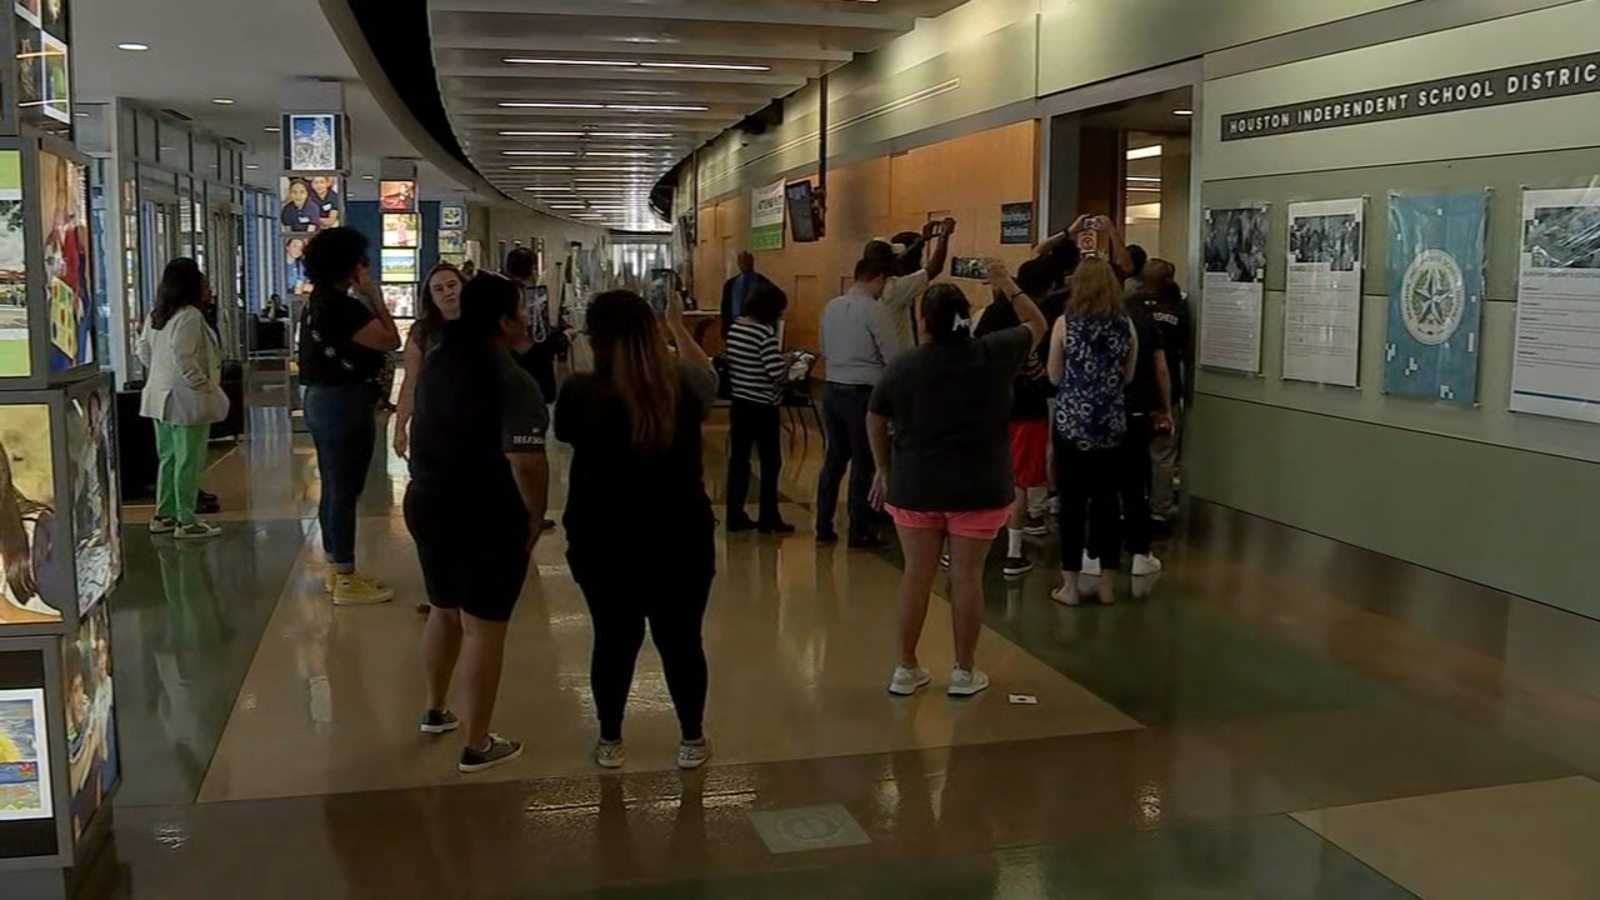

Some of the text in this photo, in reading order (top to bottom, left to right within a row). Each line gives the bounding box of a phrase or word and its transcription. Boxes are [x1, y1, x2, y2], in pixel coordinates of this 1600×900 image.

[1229, 63, 1597, 133] HOUSTON INDEPENDENT SCHOOL DISTRIC
